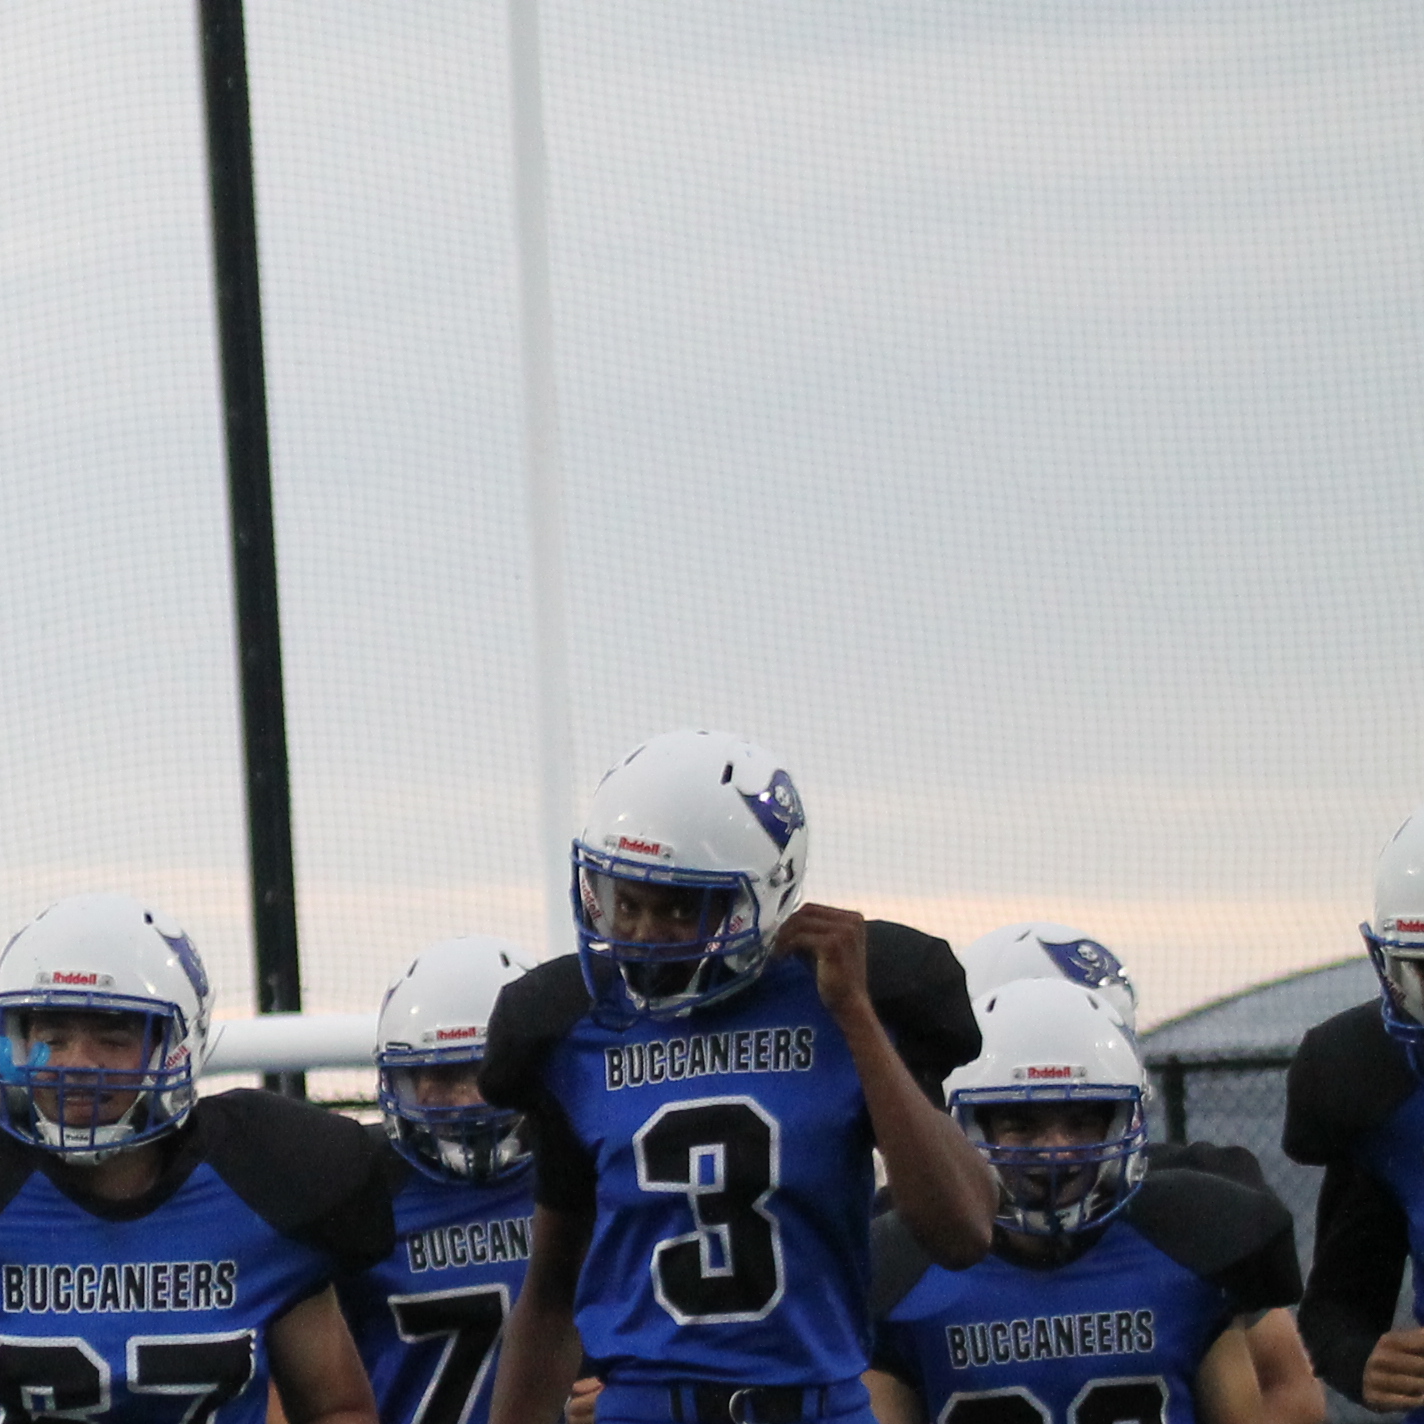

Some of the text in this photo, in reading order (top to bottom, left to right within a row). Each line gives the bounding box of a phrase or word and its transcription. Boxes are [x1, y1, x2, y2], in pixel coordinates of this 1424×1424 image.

[619, 836, 660, 856] Riddell
[53, 971, 97, 986] Riddell
[604, 1026, 815, 1091] BUCCANEERS
[1028, 1066, 1071, 1080] Riddell
[632, 1094, 786, 1326] 3
[406, 1216, 534, 1273] BUCCAN
[2, 1260, 237, 1314] BUCCANEERS
[945, 1309, 1155, 1370] BUCCANEERS
